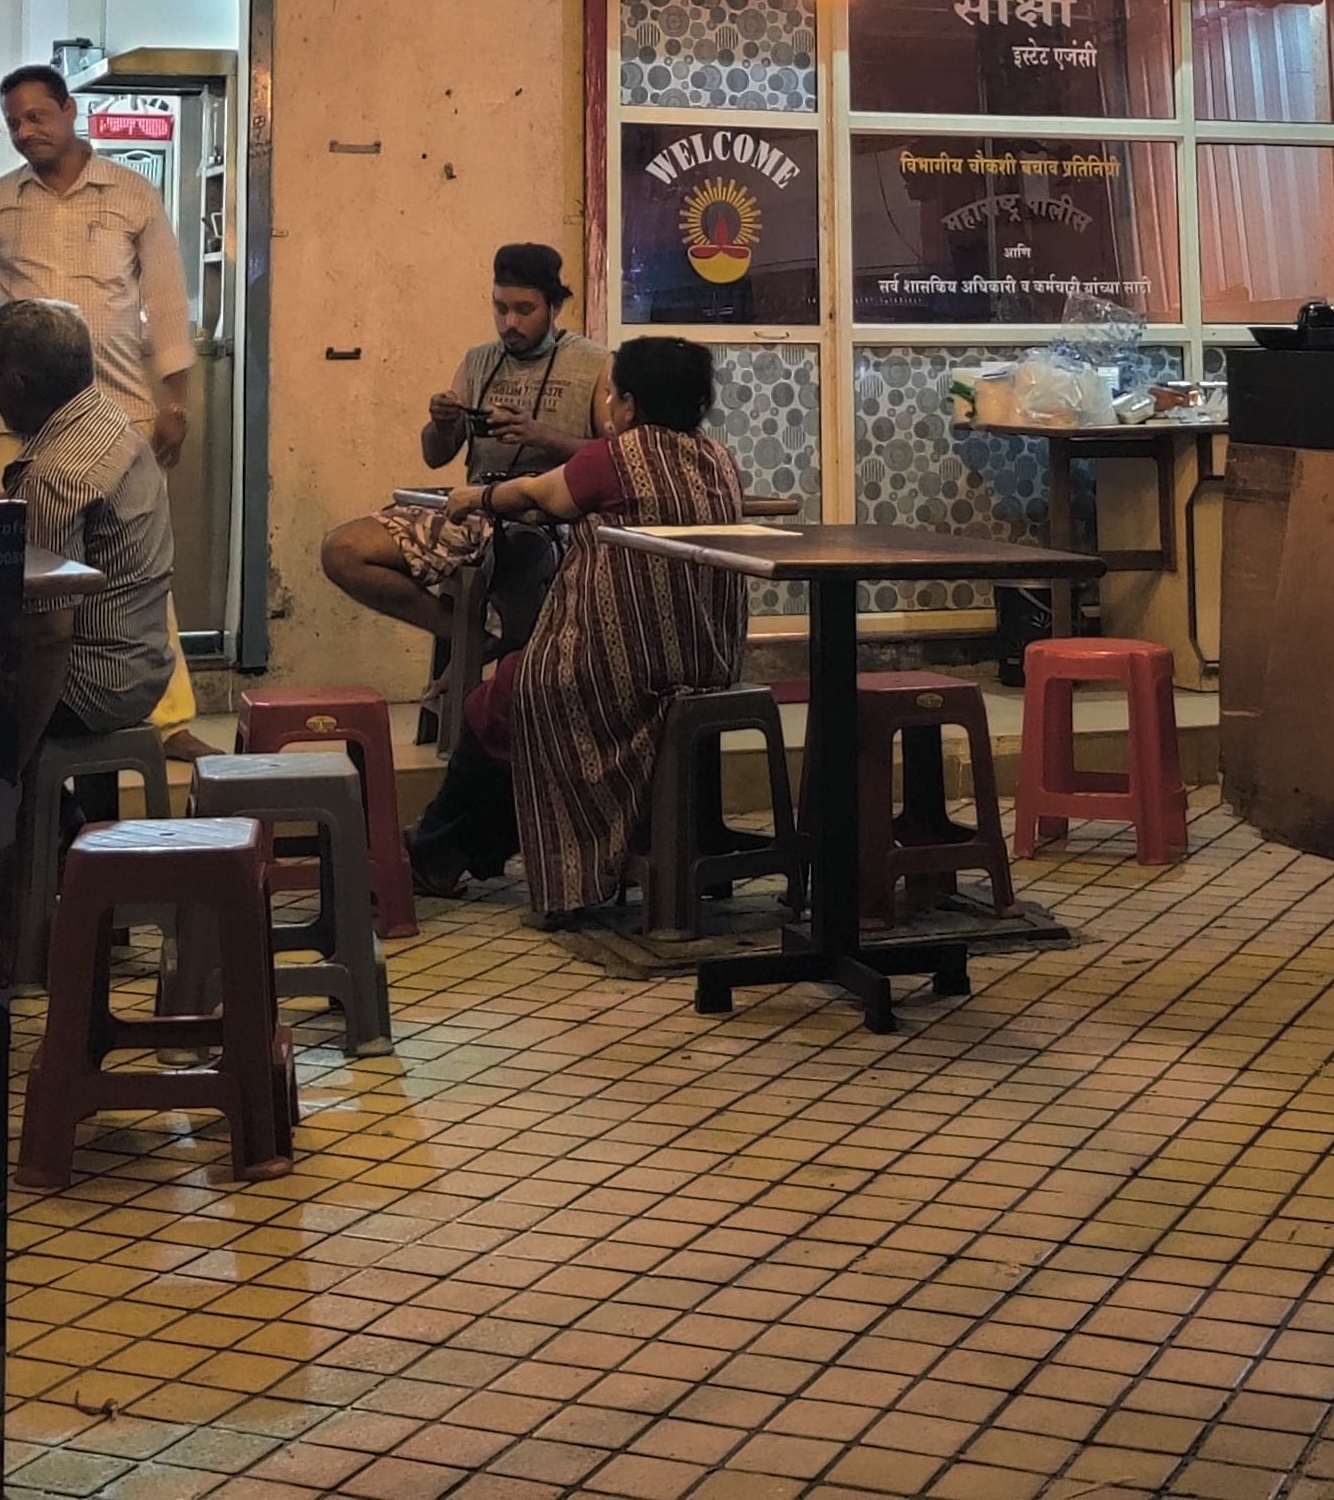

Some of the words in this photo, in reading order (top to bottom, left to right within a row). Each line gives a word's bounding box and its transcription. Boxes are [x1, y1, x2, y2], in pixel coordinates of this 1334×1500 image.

[1011, 37, 1050, 68] इस्टेट
[1053, 39, 1098, 70] एजंसी
[643, 129, 804, 190] WELCOME
[899, 150, 964, 176] विभागीय
[967, 149, 1017, 176] चौकशी
[1020, 159, 1059, 177] बचाव
[1003, 242, 1032, 259] आणि
[877, 272, 900, 294] सर्व
[903, 274, 958, 295] शासकिय
[961, 274, 1017, 295] अधिकारी
[1019, 280, 1032, 294] व
